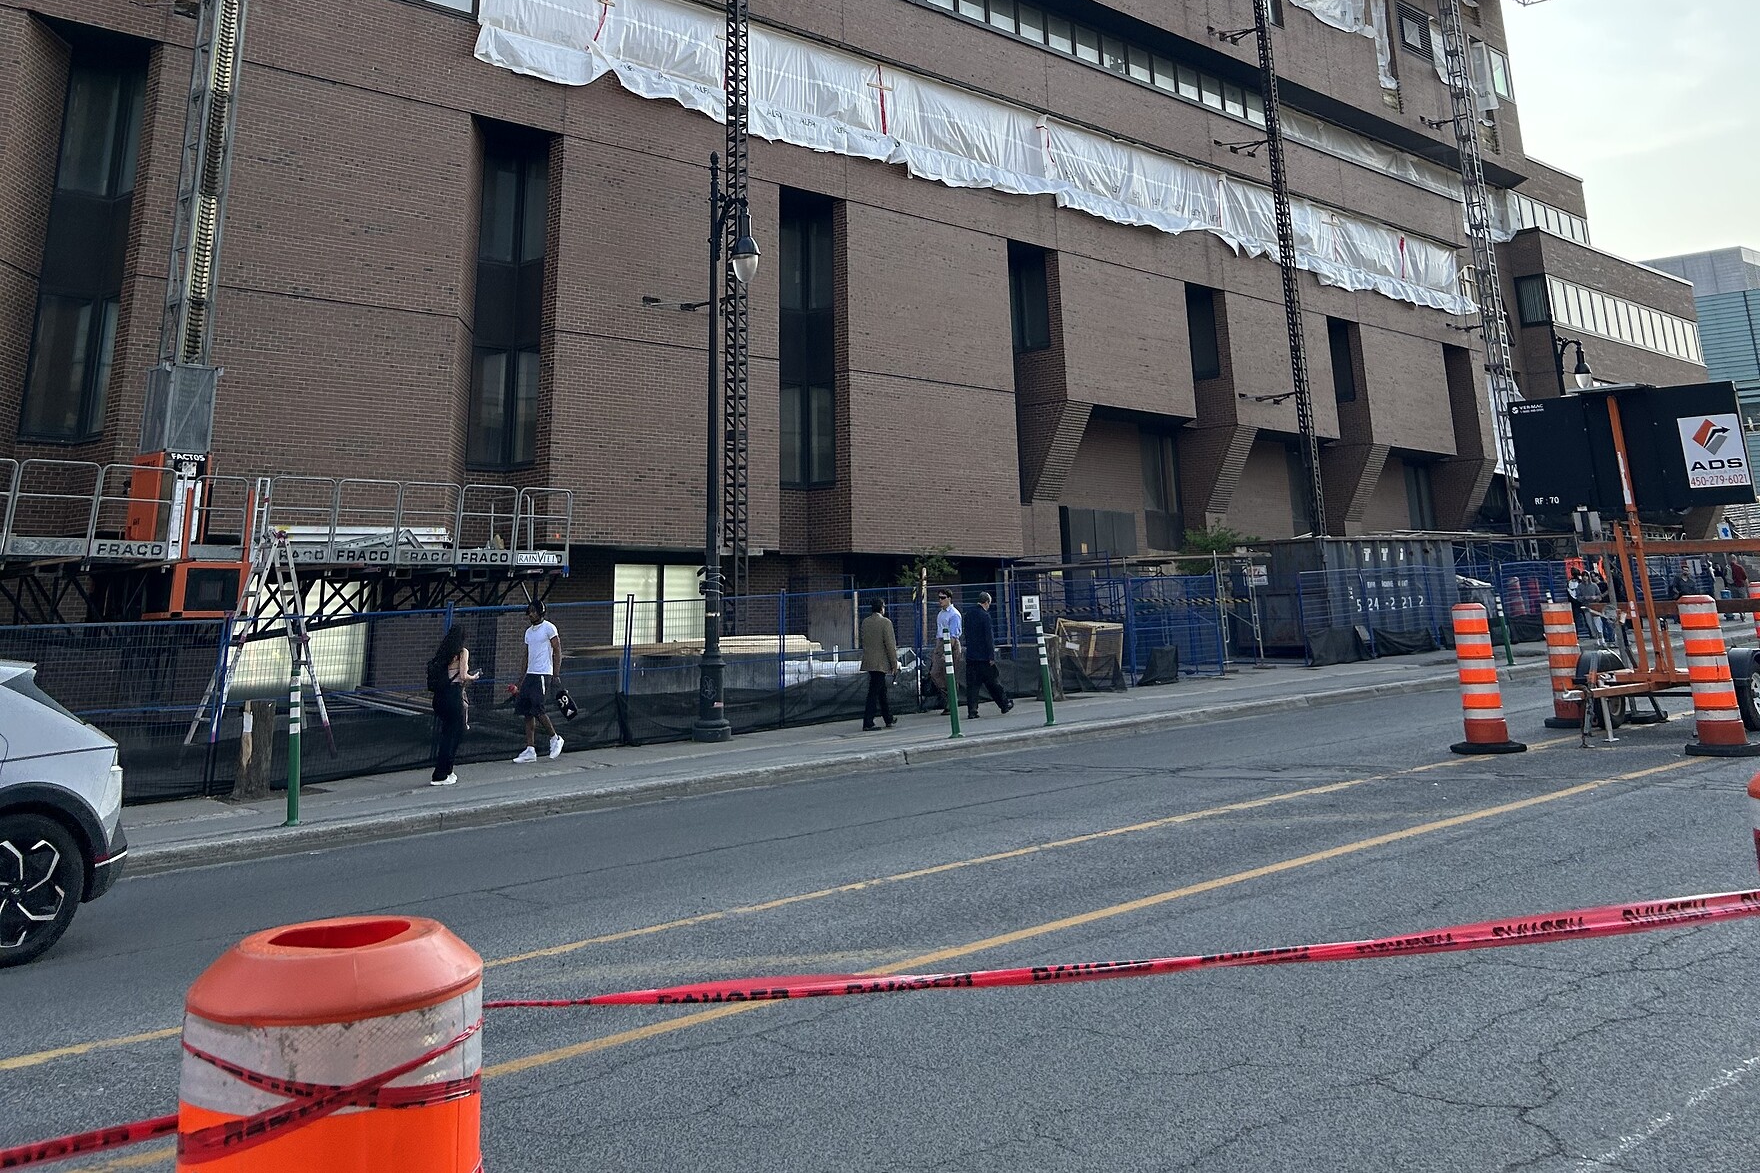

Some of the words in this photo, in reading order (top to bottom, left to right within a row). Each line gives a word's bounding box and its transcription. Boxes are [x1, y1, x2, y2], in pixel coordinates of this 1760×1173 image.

[1690, 457, 1743, 471] ADS
[1690, 473, 1748, 487] 450-279-6021
[1549, 496, 1560, 504] 70
[97, 543, 163, 556] FRACO
[336, 550, 389, 561] FRACO
[461, 552, 509, 563] FRACO
